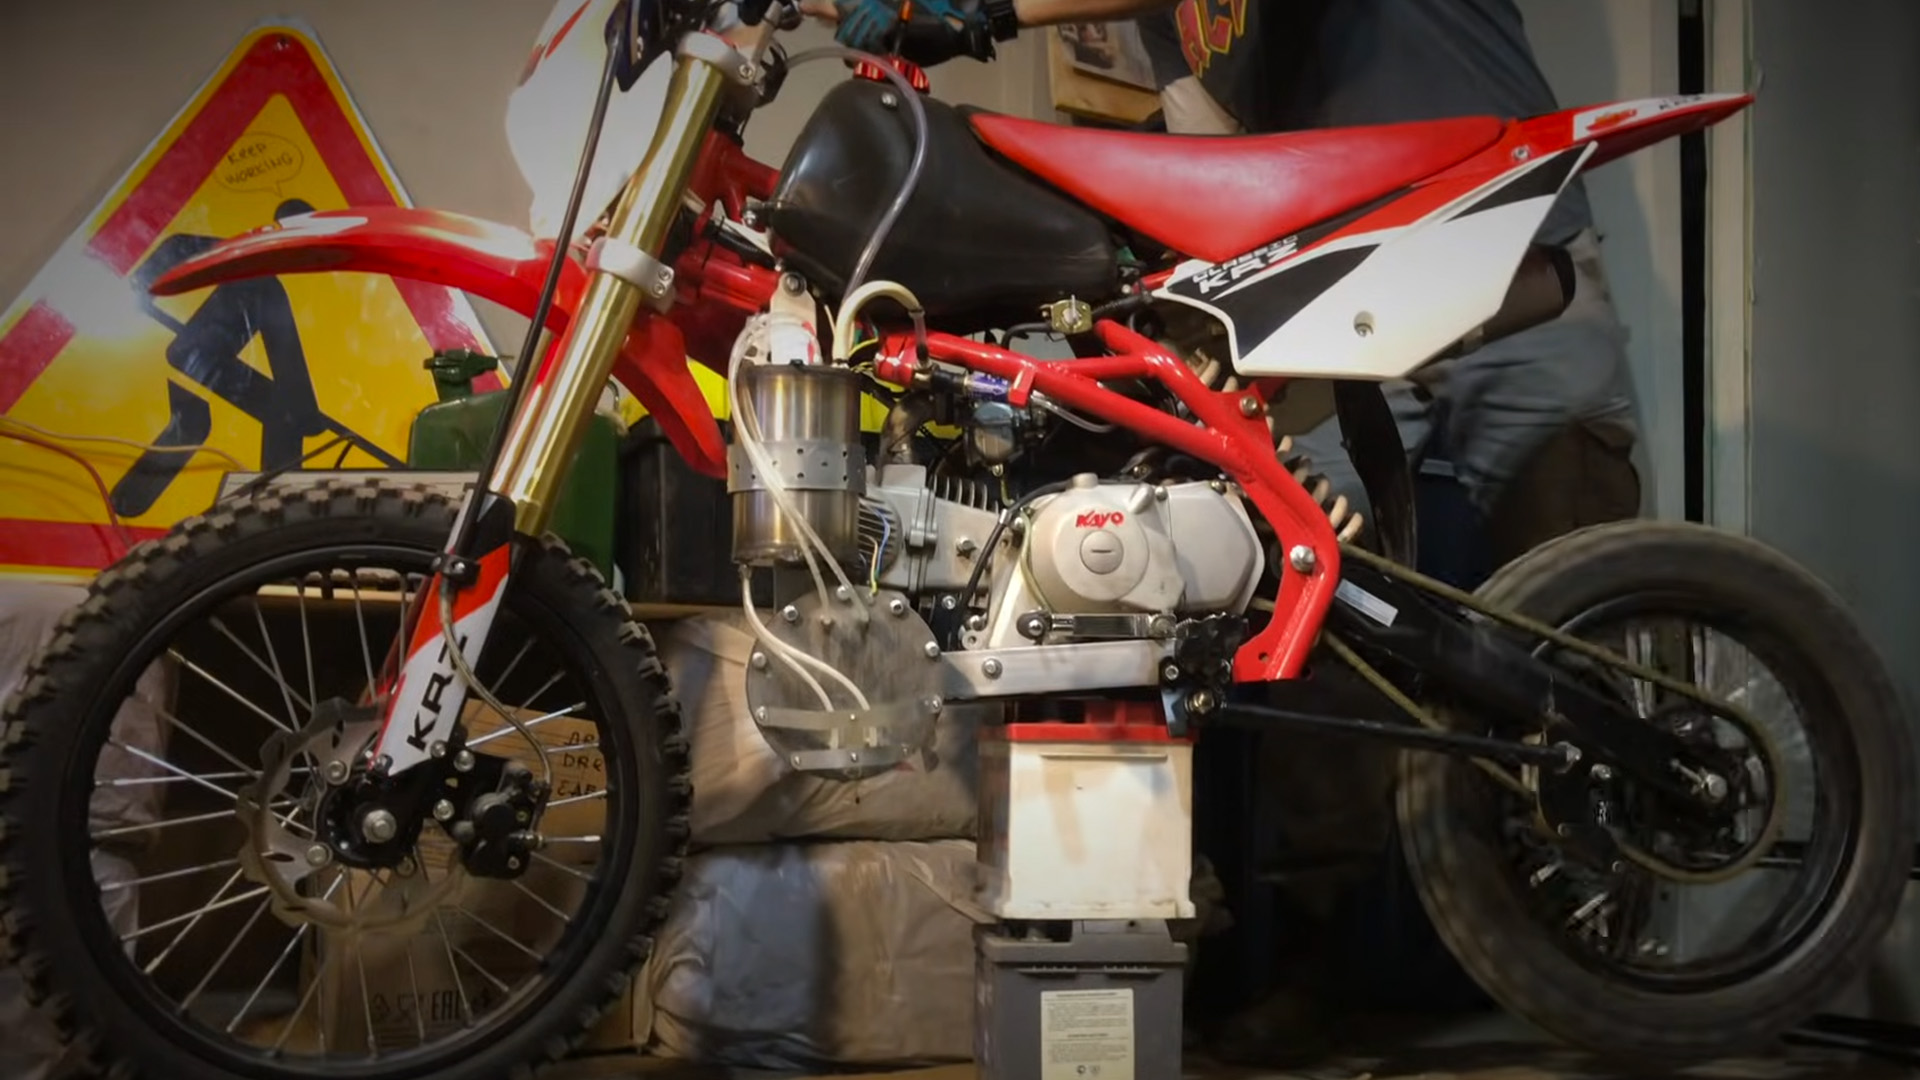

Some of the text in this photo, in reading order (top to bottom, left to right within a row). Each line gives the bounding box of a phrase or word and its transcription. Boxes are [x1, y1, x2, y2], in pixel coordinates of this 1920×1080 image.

[225, 152, 293, 184] WORKING
[1199, 242, 1298, 294] KRZ
[1075, 510, 1124, 529] KAYO
